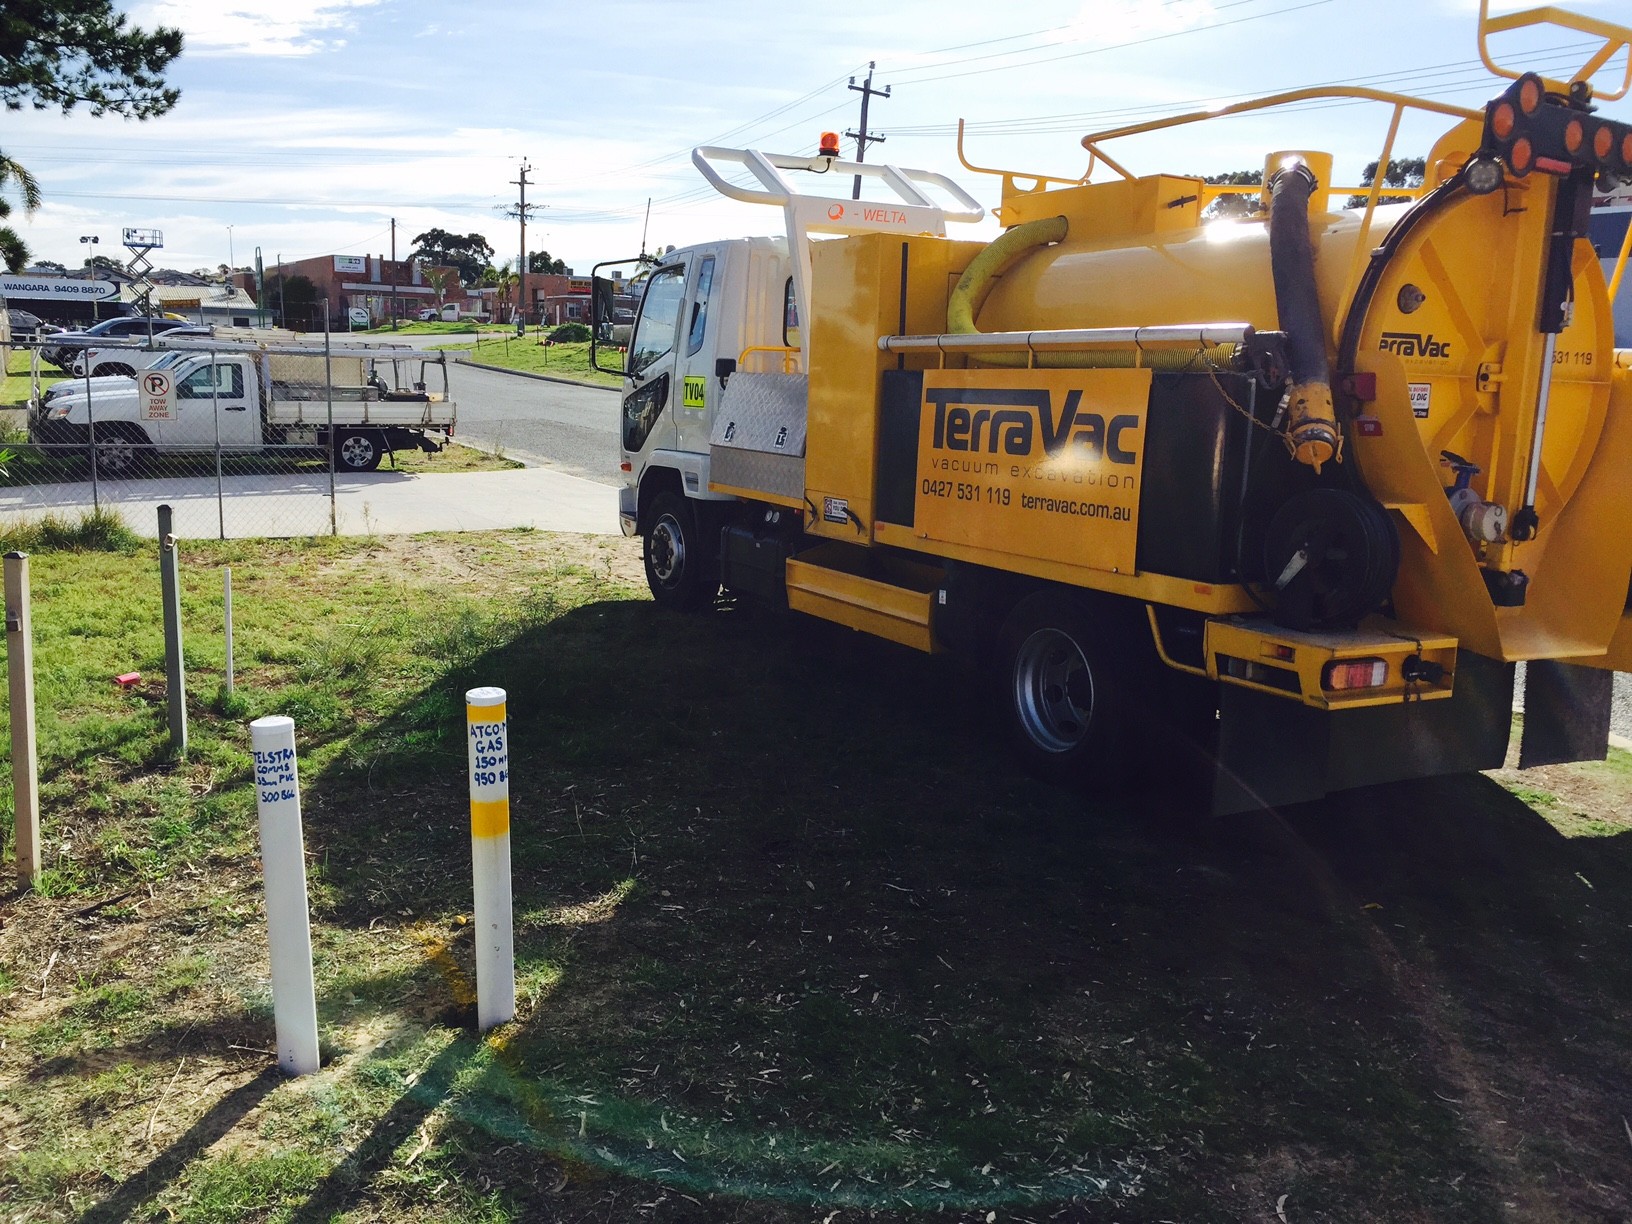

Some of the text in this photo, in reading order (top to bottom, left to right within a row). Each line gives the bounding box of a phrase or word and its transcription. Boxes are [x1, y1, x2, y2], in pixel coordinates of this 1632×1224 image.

[863, 208, 907, 224] WELTA
[3, 283, 105, 294] WANGARA 9409 8870
[1379, 332, 1450, 358] erraVac
[1575, 351, 1592, 365] 119
[684, 382, 704, 401] TV04
[1416, 393, 1428, 401] DIG
[926, 388, 1139, 465] TerraVac
[931, 457, 1135, 489] vacuum excavation
[922, 478, 1131, 521] 0427 531 119 terravac.com.au
[475, 737, 503, 754] GAS
[252, 748, 294, 764] TELSTRA
[475, 756, 497, 769] 150
[257, 763, 290, 774] COMMS
[279, 772, 294, 783] PVC
[474, 771, 496, 787] 950
[262, 791, 280, 803] 500
